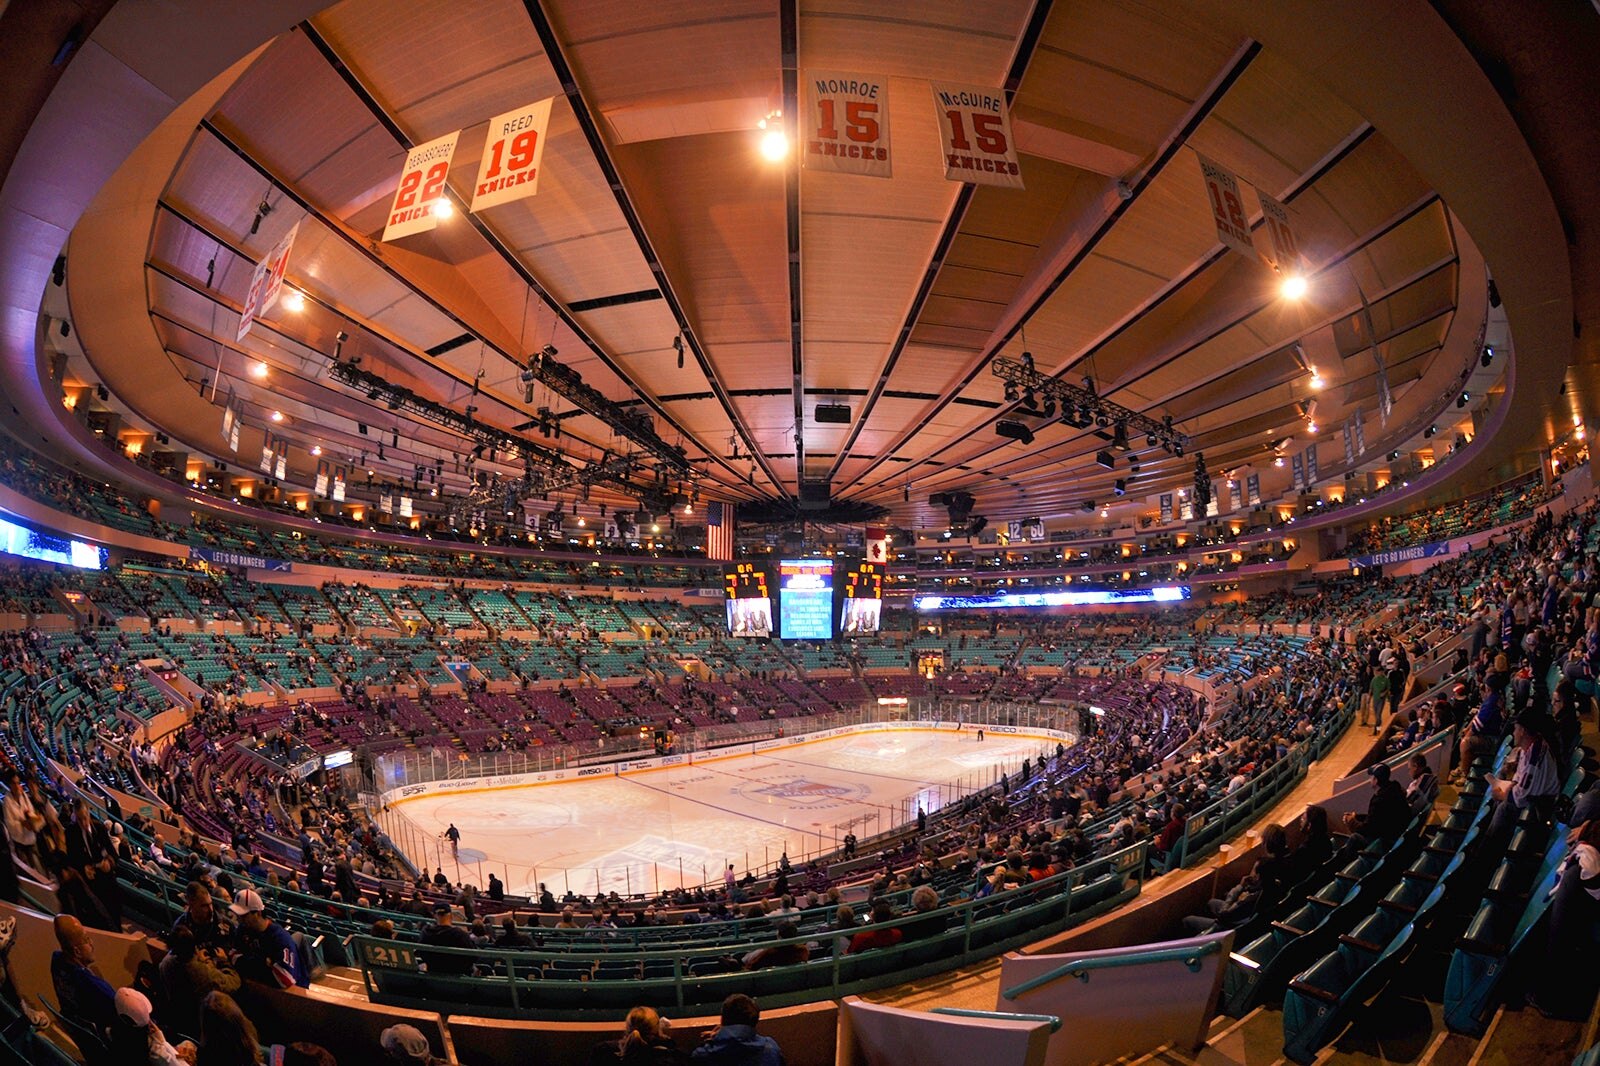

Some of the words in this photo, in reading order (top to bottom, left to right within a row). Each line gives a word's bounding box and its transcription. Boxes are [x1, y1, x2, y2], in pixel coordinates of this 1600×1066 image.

[816, 79, 879, 99] MONROE
[939, 91, 1001, 113] McGUIRE
[503, 114, 533, 136] REED
[817, 99, 880, 144] 15
[946, 110, 1008, 155] 15
[485, 129, 538, 180] 19
[808, 141, 888, 162] KNICKS
[946, 154, 1019, 176] KNICKS
[394, 161, 449, 211] 22
[476, 168, 537, 198] KNICKS
[1208, 181, 1246, 231] 12
[1009, 522, 1021, 540] 12
[212, 551, 230, 563] LET'S
[230, 554, 238, 564] GO
[239, 555, 266, 568] RANGERS
[1372, 552, 1389, 565] LET'S
[1389, 552, 1398, 562] GO
[1399, 546, 1425, 560] RANGERS
[283, 947, 295, 968] 11
[374, 946, 412, 965] 211
